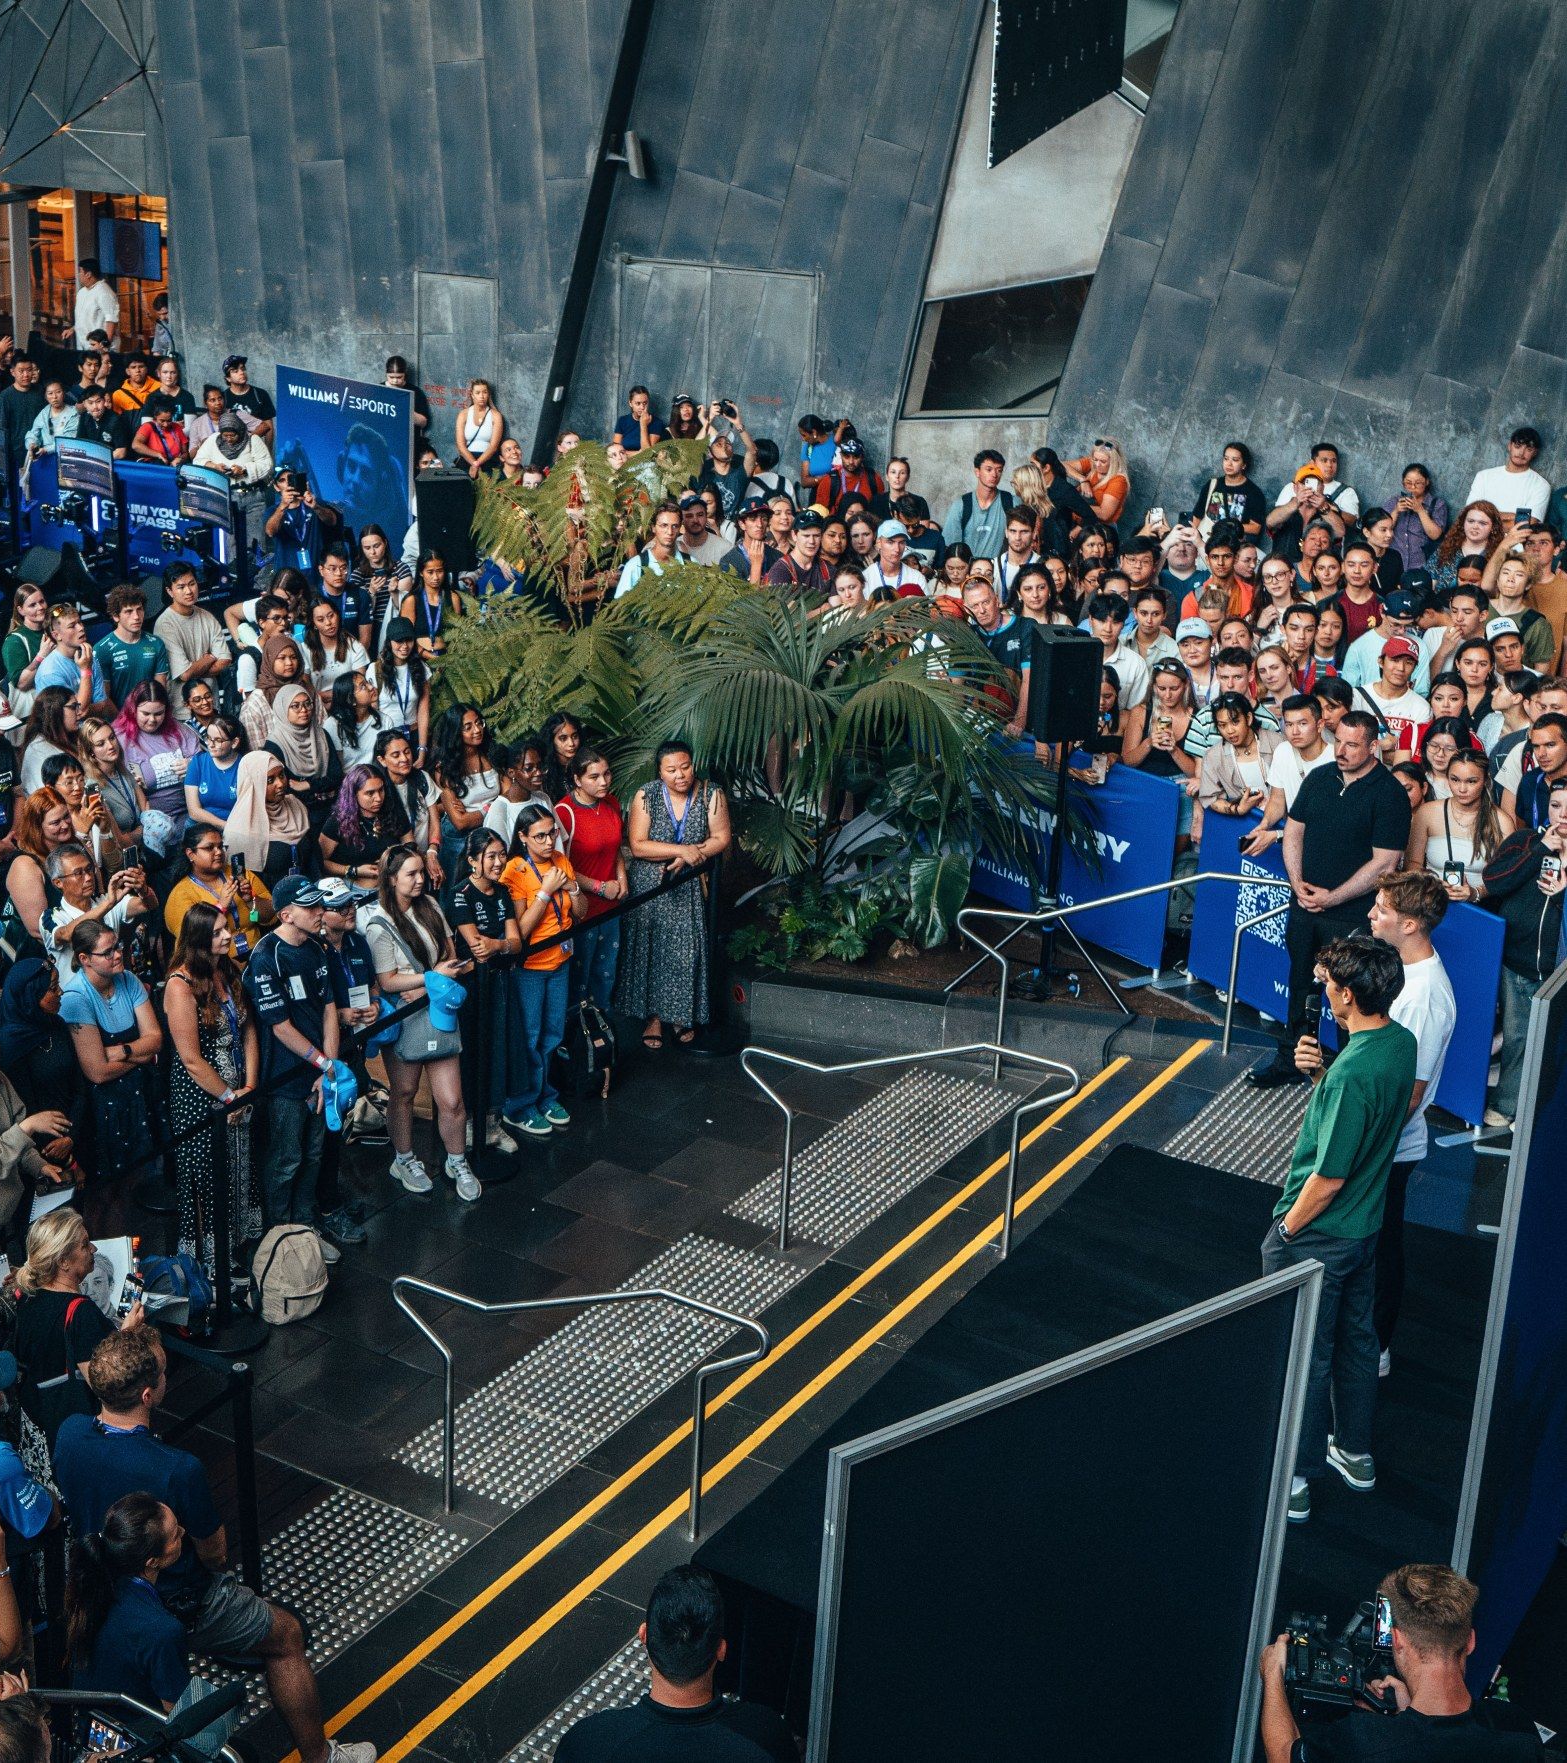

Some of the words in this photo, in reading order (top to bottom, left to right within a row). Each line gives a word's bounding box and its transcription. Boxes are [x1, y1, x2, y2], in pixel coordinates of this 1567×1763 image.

[288, 383, 340, 405] WILLIAMS
[348, 395, 397, 418] ESPORTS
[136, 515, 177, 531] PASS
[977, 857, 1031, 888] WILLIAMS
[259, 1001, 278, 1012] Allianz
